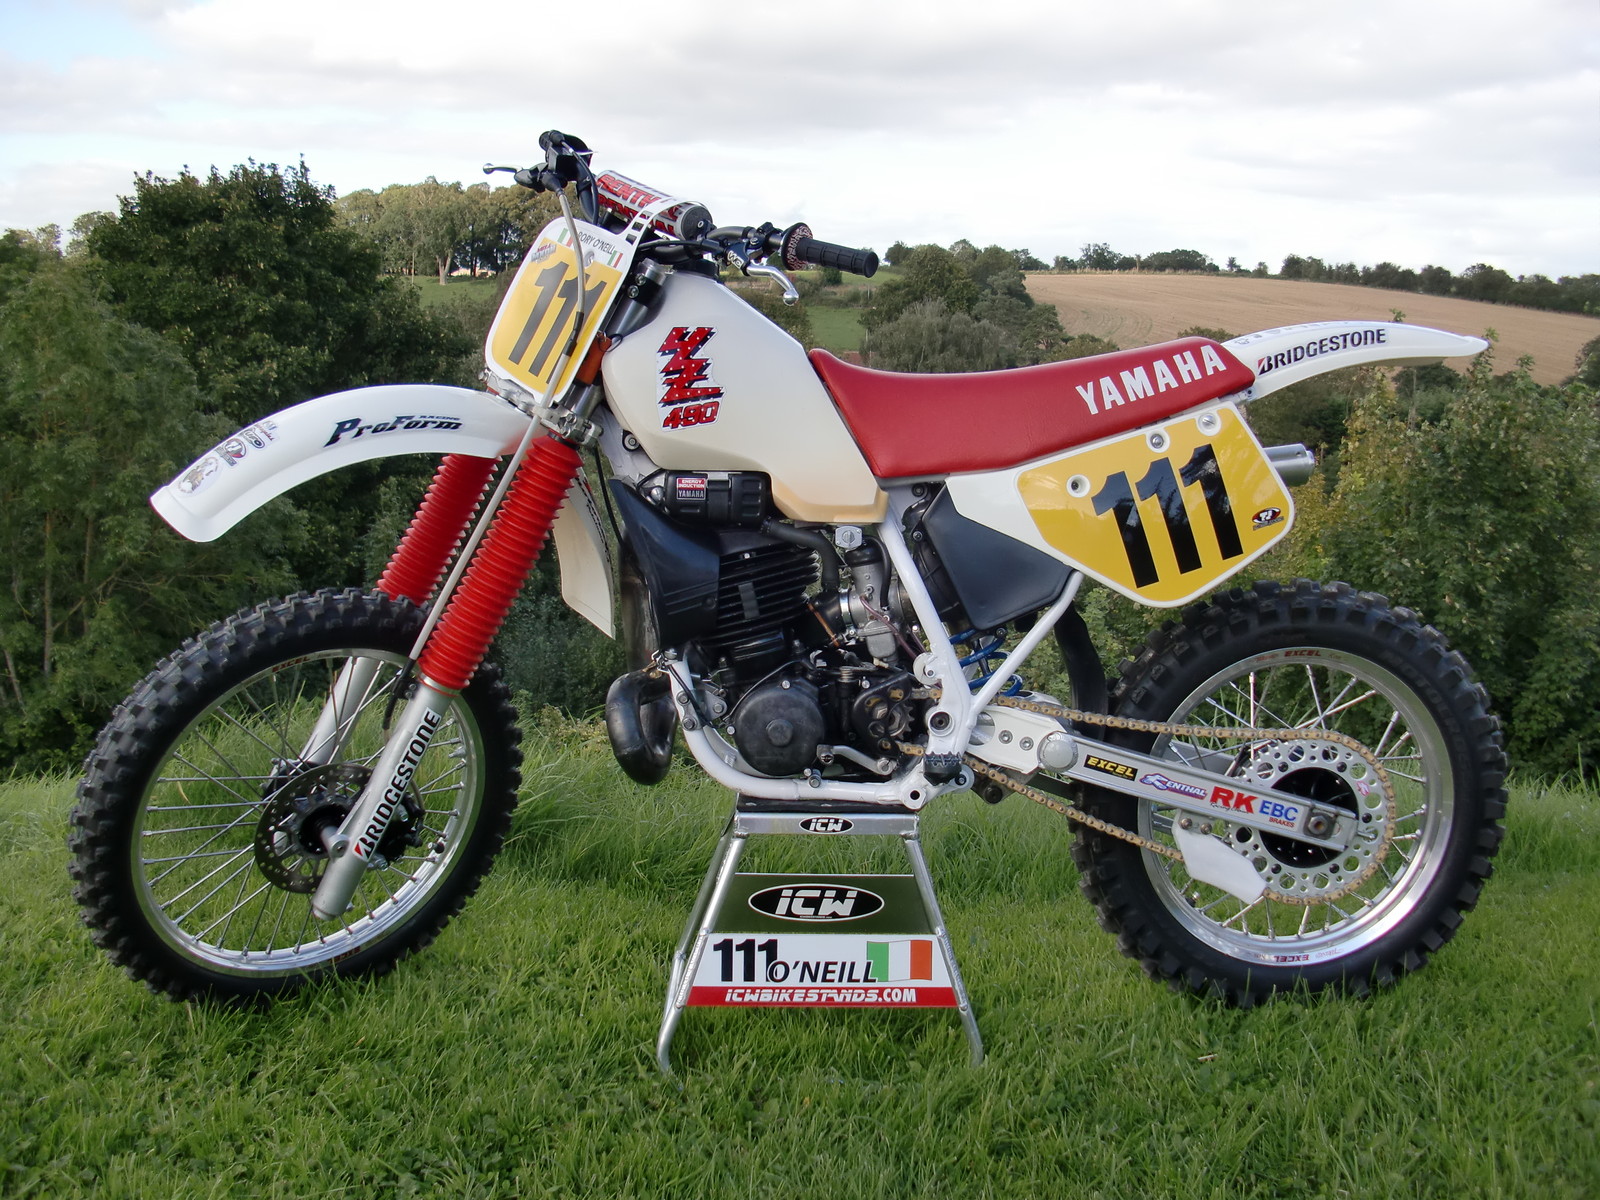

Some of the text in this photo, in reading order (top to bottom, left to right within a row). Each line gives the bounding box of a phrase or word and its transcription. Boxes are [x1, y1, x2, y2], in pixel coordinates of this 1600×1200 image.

[596, 174, 684, 222] RENTHL
[593, 238, 616, 255] O'NEILL
[1257, 328, 1387, 376] BRIDGESTONE
[1075, 344, 1227, 415] YAMAHA
[662, 401, 720, 429] 490
[678, 490, 704, 498] YAMAHA
[1091, 443, 1244, 589] 111
[272, 656, 310, 672] EXCEL
[1087, 756, 1135, 777] EXCEL
[354, 711, 441, 860] BRIDGESTONE
[1210, 786, 1258, 814] RK
[1259, 800, 1298, 821] EBC
[809, 818, 843, 832] ICW
[1269, 816, 1295, 828] BRAKES
[775, 889, 857, 916] ICW
[713, 938, 778, 983] 111
[1273, 953, 1310, 963] EXCEL
[768, 961, 877, 983] O'NEILL
